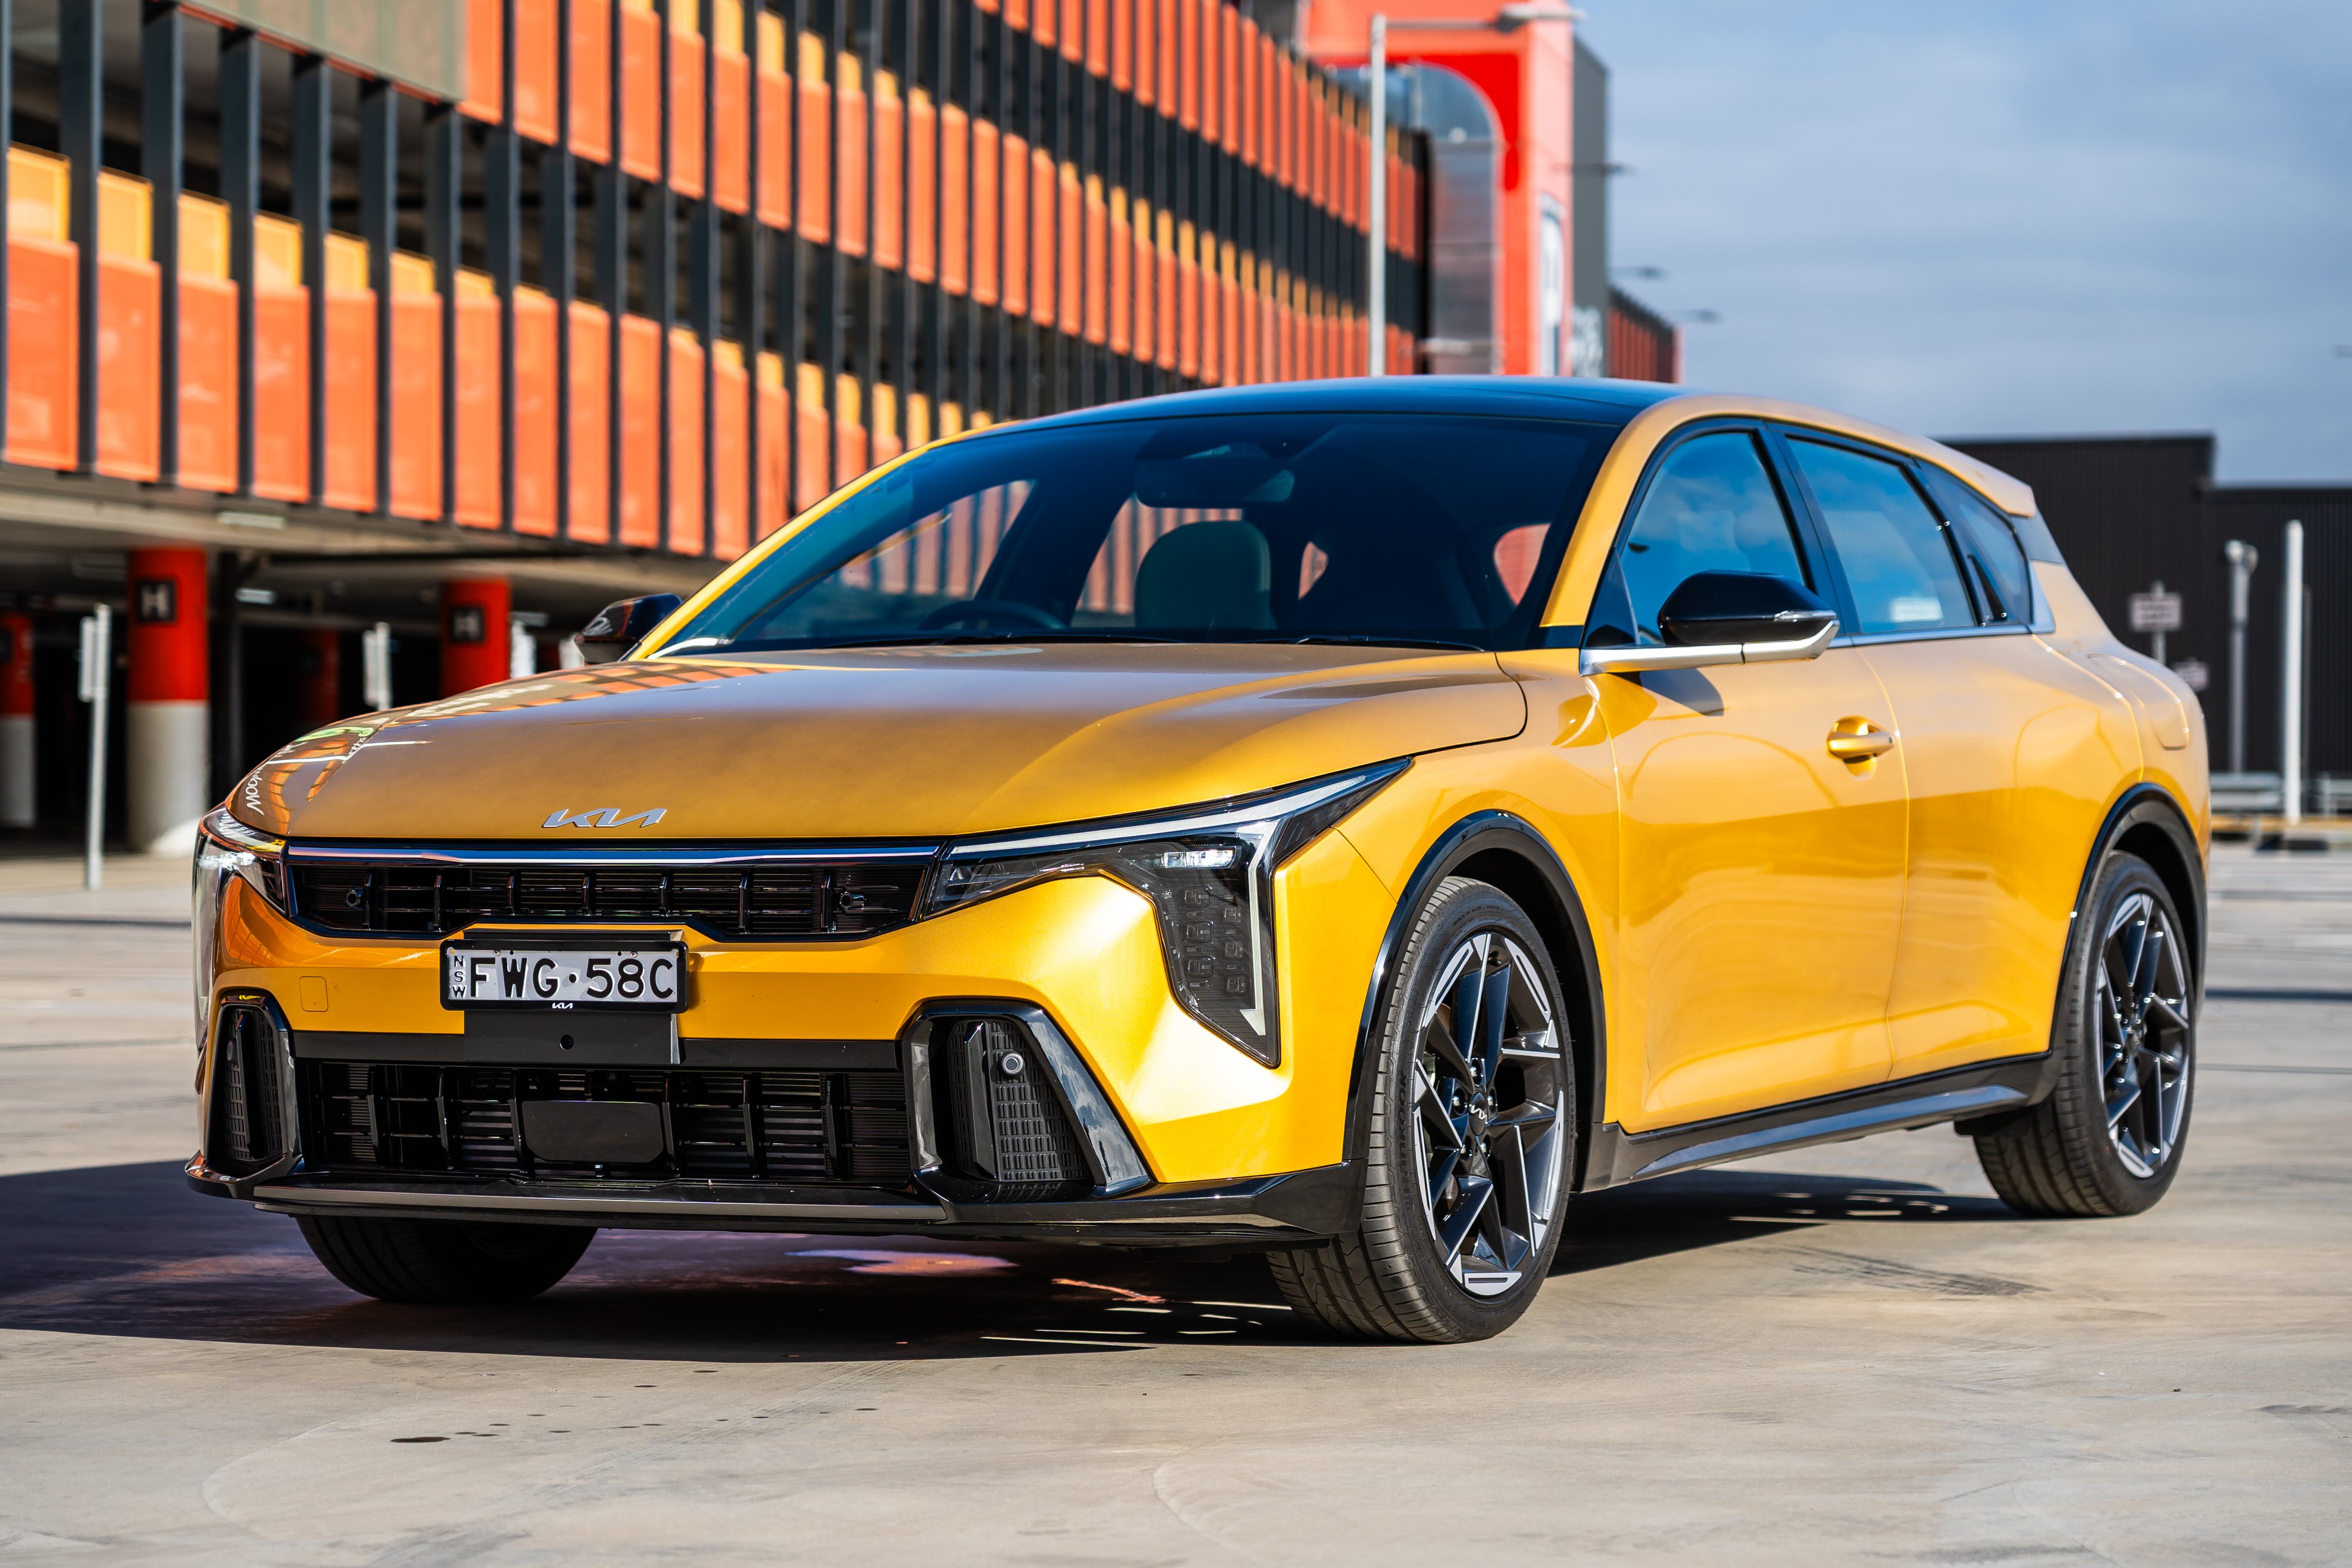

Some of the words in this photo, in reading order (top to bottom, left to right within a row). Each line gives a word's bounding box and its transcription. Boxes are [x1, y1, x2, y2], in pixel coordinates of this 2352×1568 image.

[142, 584, 169, 618] H
[542, 808, 667, 828] KIA
[452, 955, 466, 998] NSW
